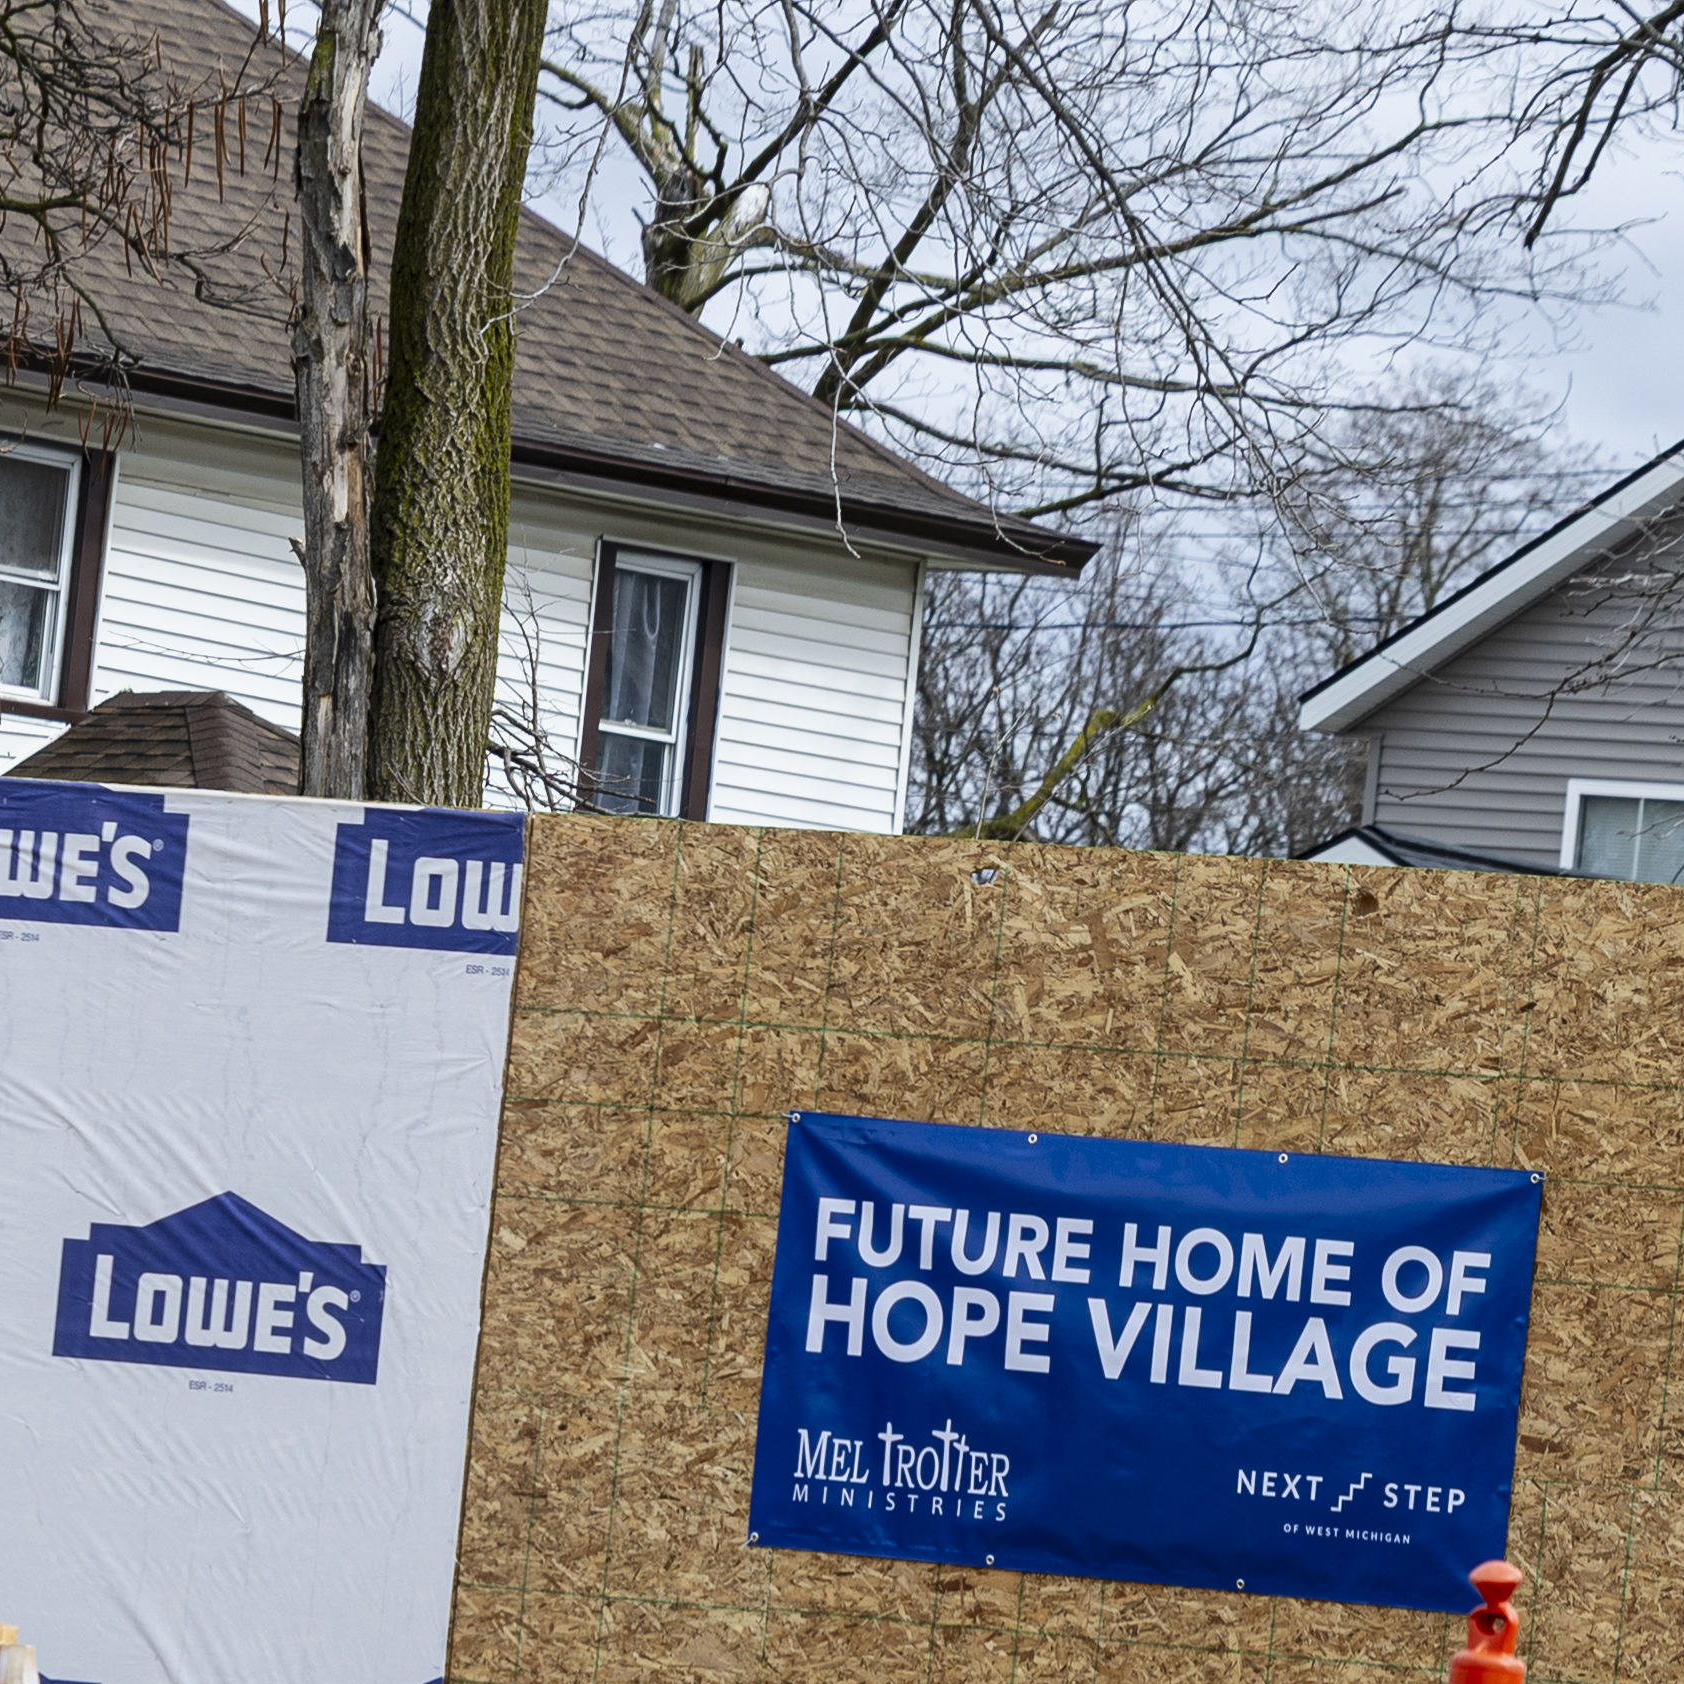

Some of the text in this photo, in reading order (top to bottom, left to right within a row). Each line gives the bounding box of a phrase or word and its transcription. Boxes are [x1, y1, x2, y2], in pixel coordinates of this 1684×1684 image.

[364, 838, 525, 933] LOW
[466, 964, 484, 975] ESR
[814, 1196, 1492, 1316] FUTURE HOME OF
[89, 1254, 349, 1360] LOWE'S
[805, 1273, 1481, 1412] HOPE VILLAGE
[793, 1418, 1010, 1498] MEL TROTTER
[1236, 1468, 1466, 1514] NEXT STEP
[792, 1483, 1007, 1522] MINISTRIES
[1283, 1523, 1411, 1545] OF WEST MICHIGAN
